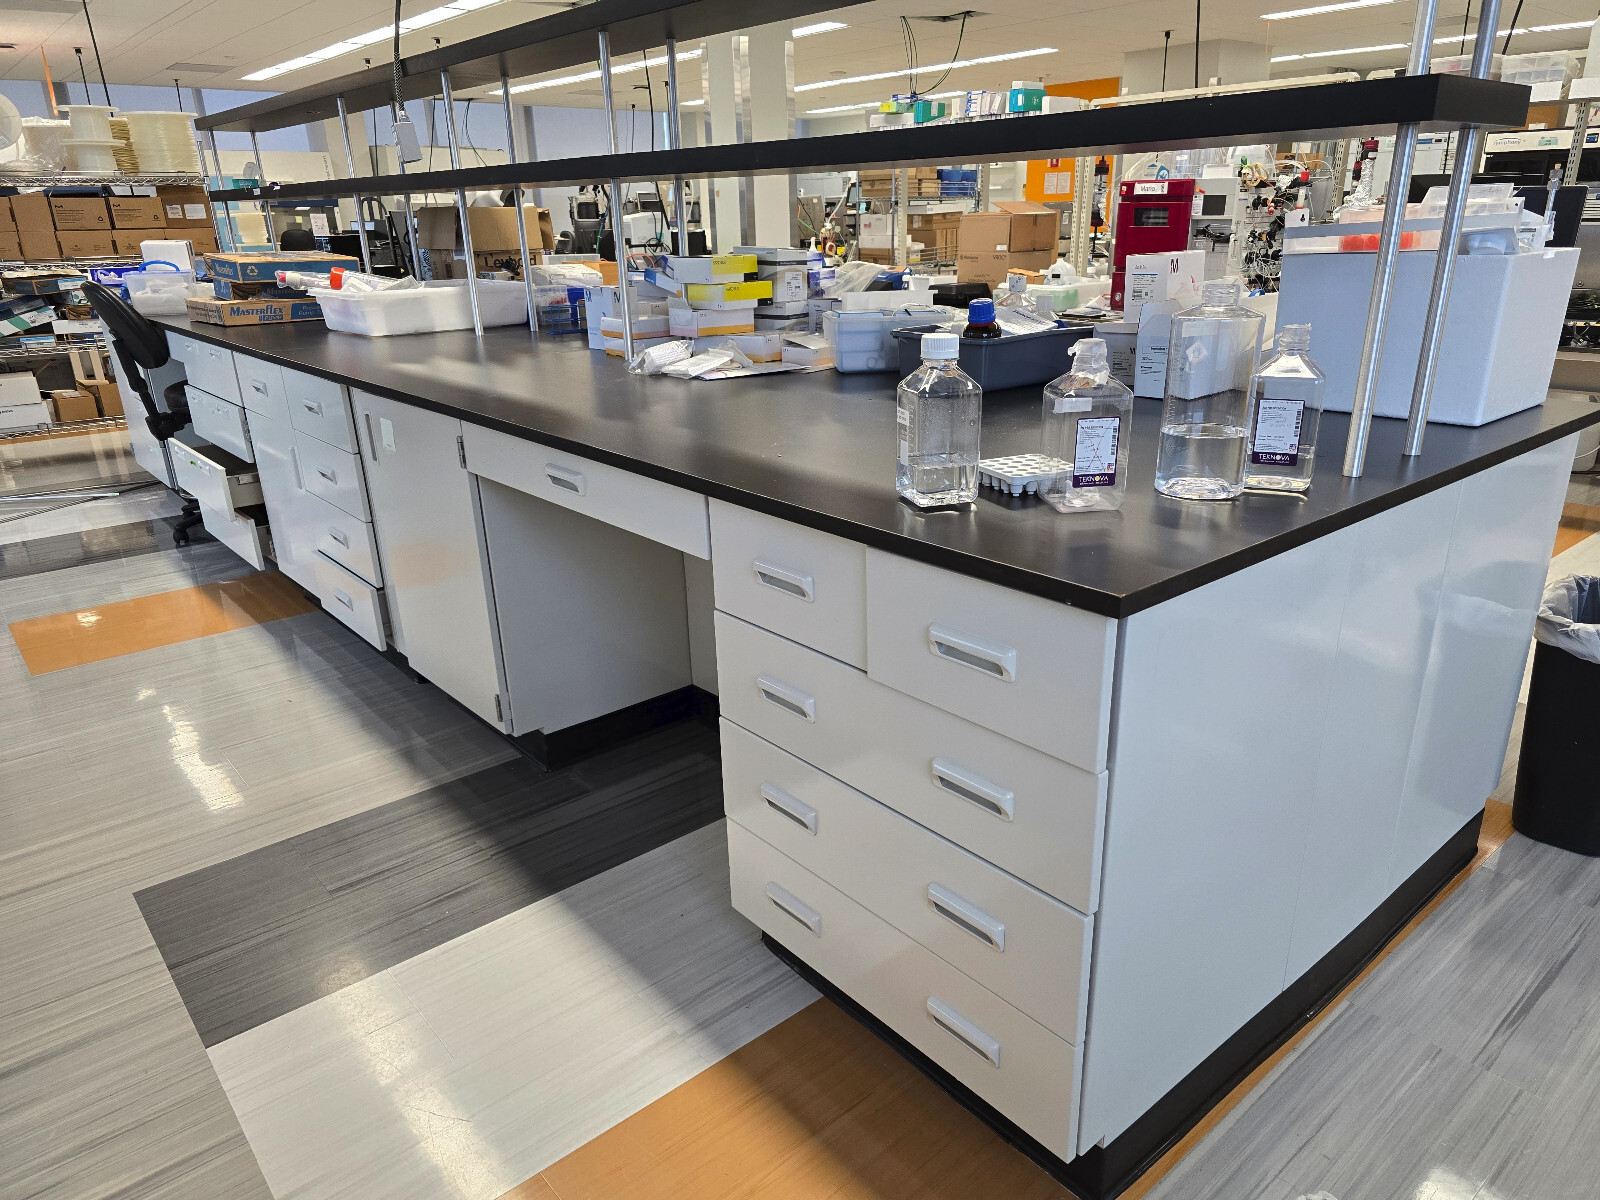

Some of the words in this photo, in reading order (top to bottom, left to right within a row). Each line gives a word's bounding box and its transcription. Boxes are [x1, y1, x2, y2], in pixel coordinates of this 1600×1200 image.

[484, 255, 537, 269] Leybod
[1258, 453, 1290, 461] TEKNOVA
[1078, 475, 1109, 484] TEKNOVA
